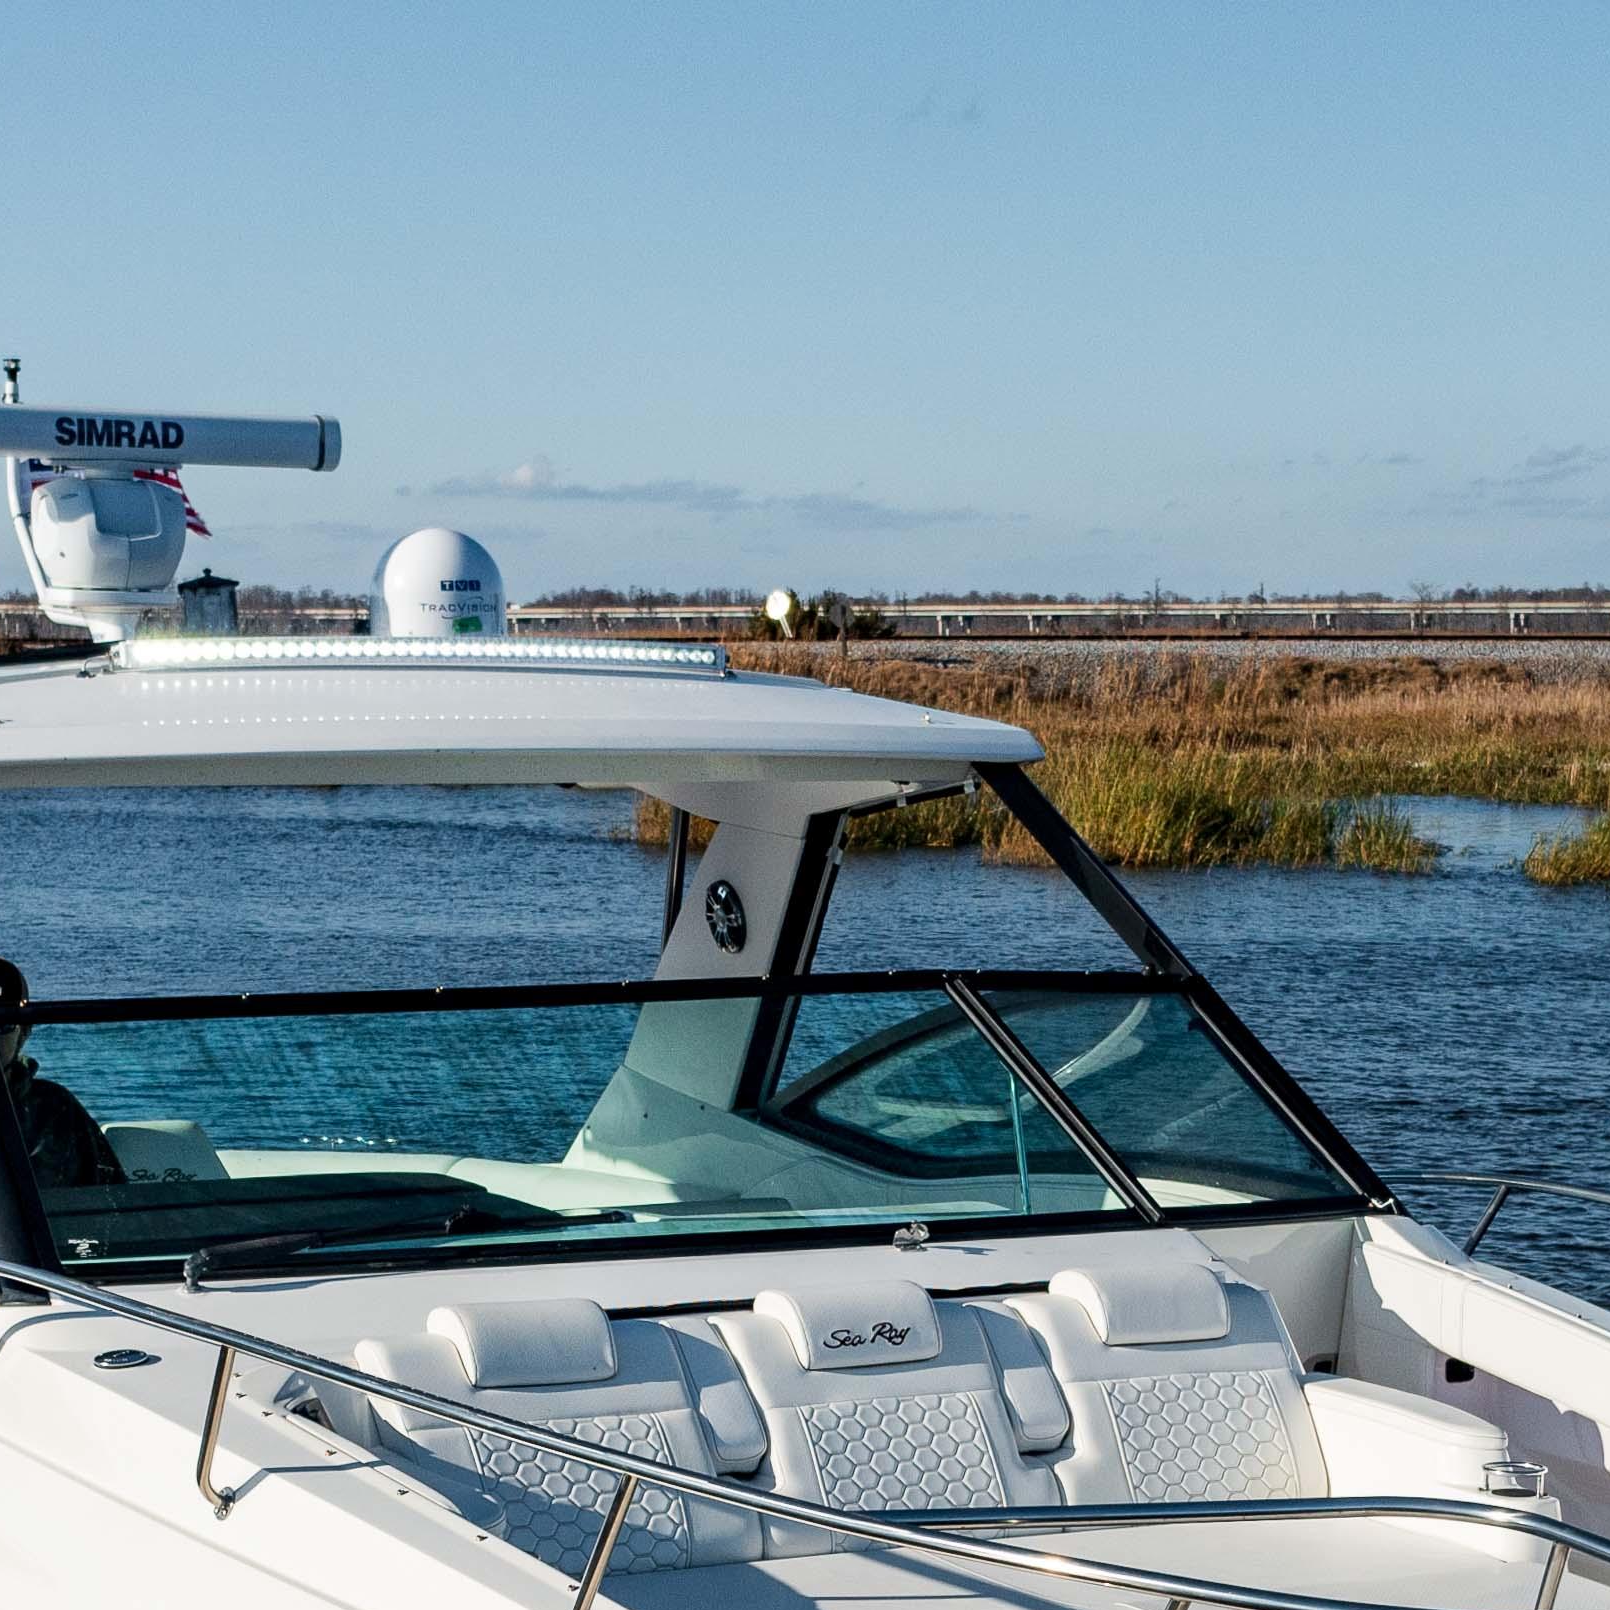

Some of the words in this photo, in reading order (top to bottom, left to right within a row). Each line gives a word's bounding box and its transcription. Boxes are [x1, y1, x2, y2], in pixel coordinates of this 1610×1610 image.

[54, 416, 184, 449] SIMRAD
[823, 1329, 867, 1348] Sea
[870, 1322, 911, 1345] Ray
